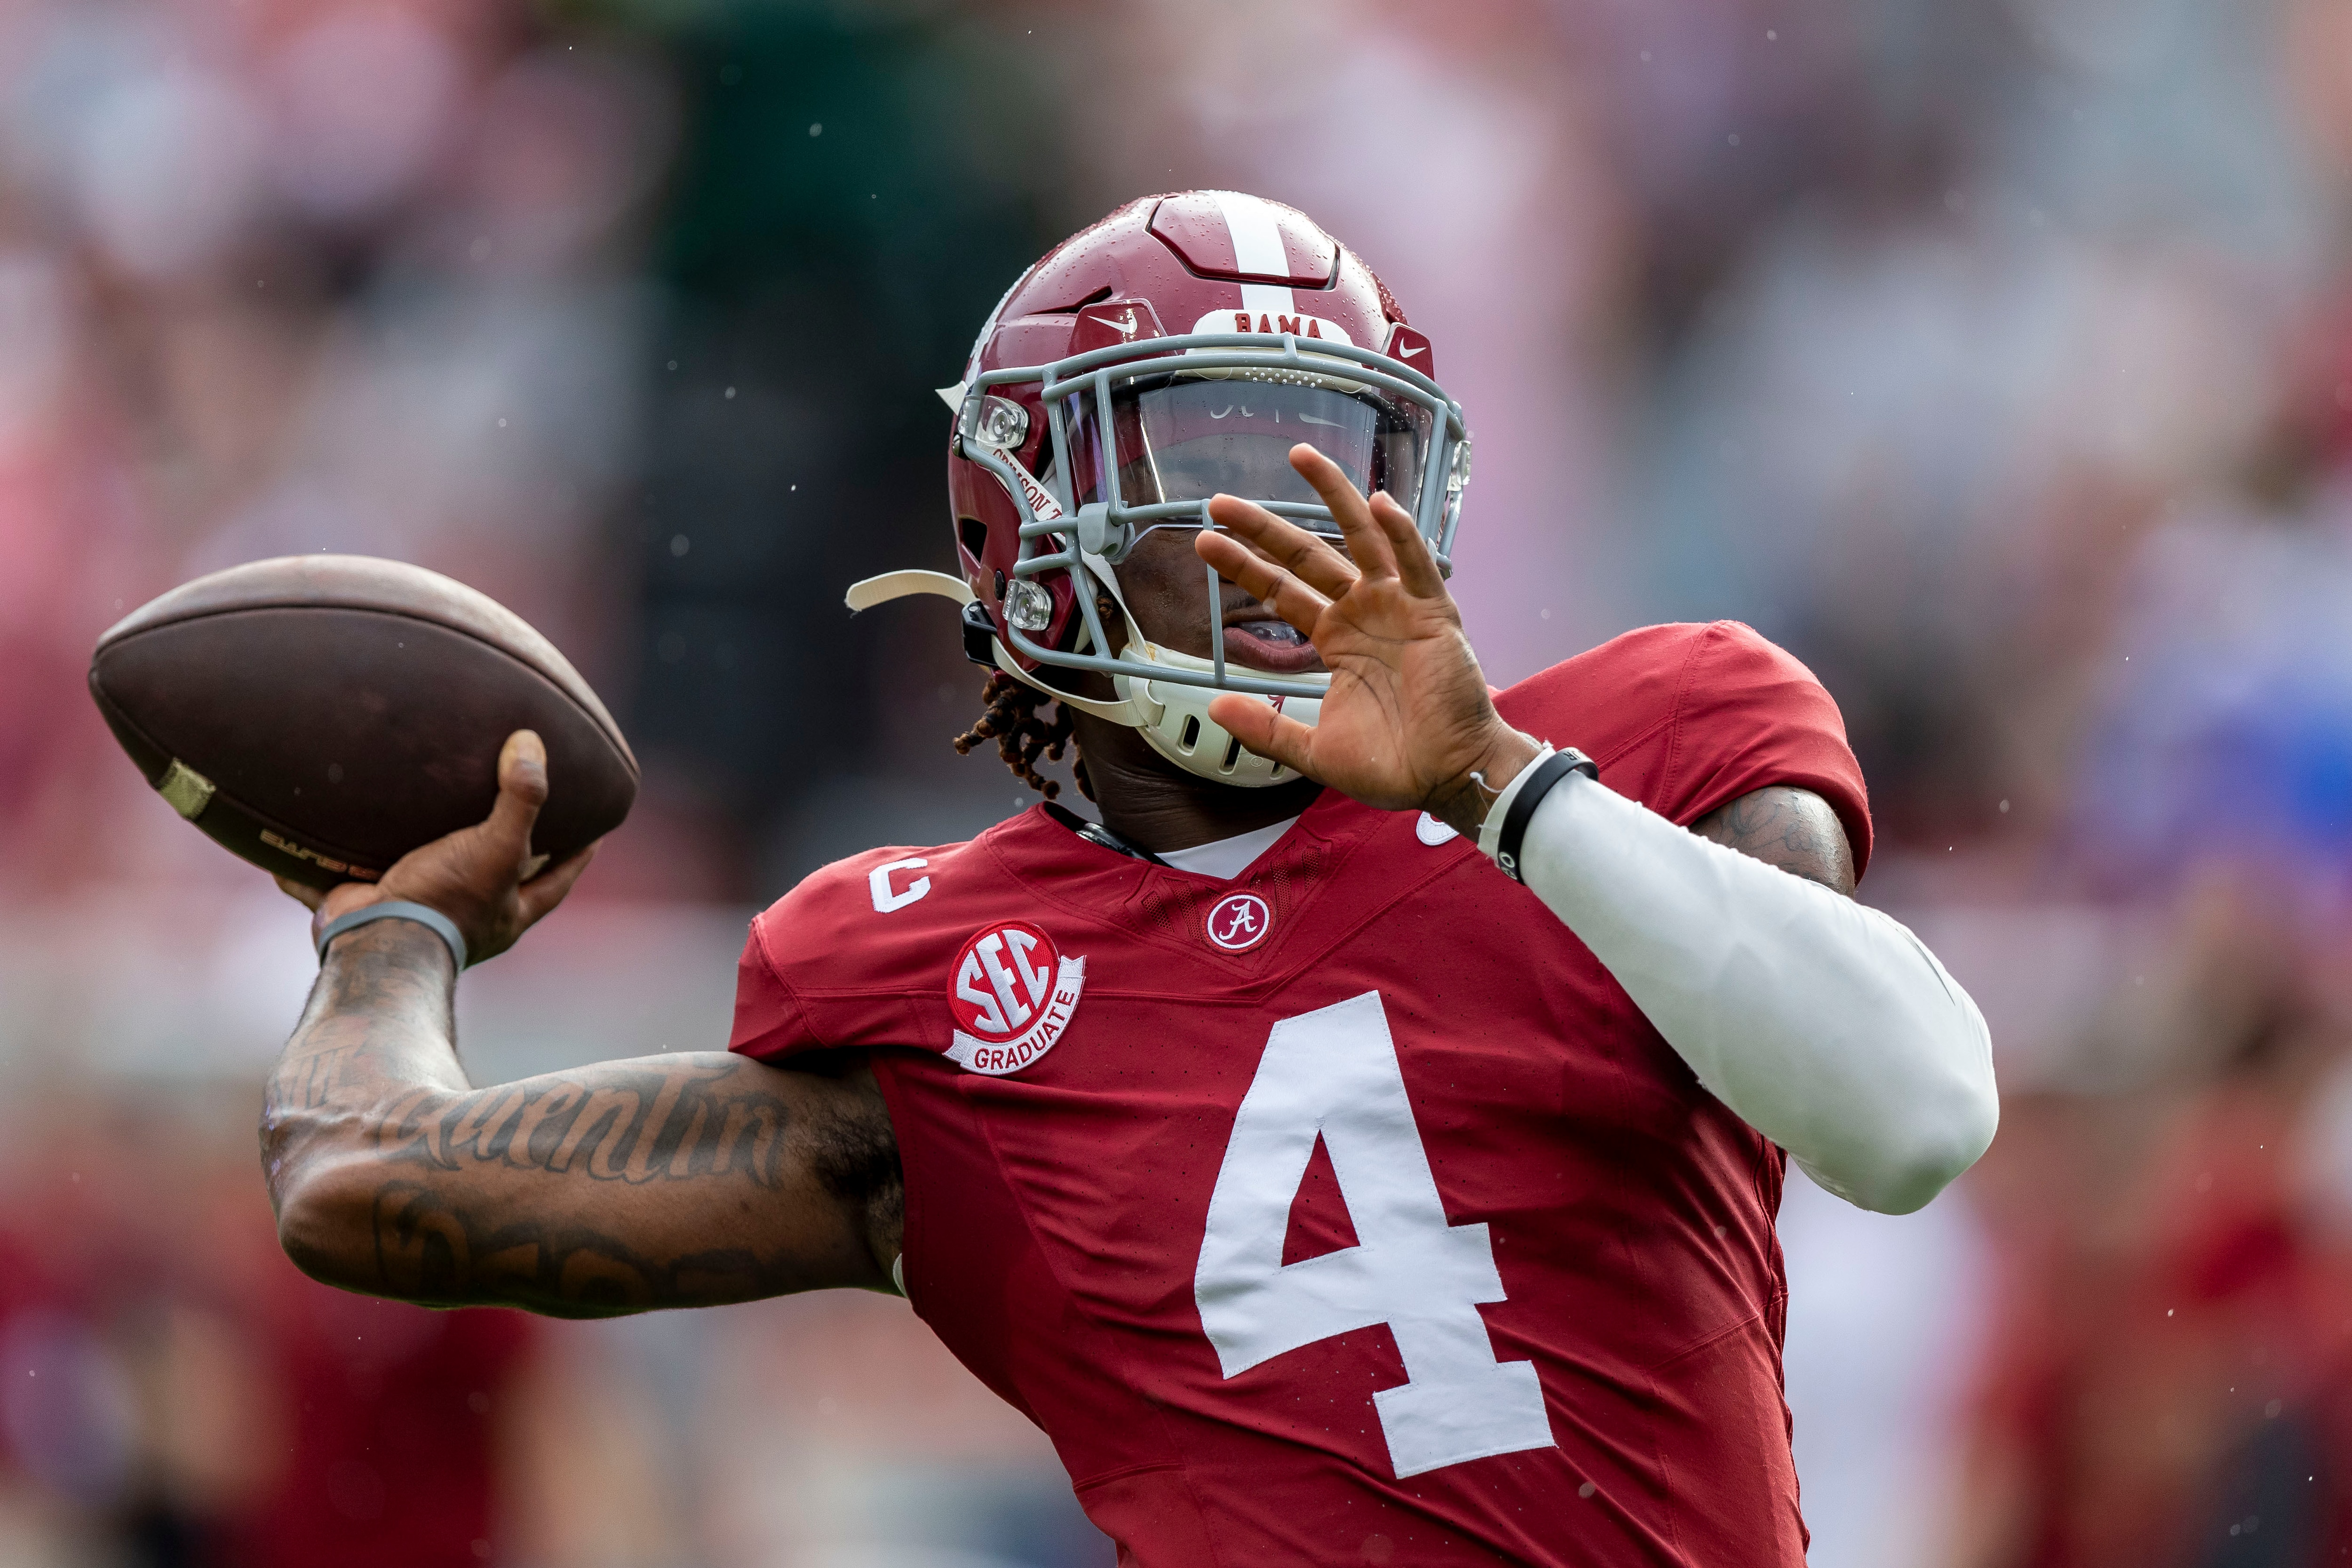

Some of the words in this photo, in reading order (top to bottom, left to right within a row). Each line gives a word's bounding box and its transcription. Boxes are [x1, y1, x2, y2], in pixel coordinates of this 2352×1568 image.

[1234, 313, 1323, 339] BAMA
[868, 857, 932, 914] C
[1218, 900, 1257, 940] A
[956, 929, 1049, 1033] SEC
[975, 990, 1075, 1070] GRADUATE
[1194, 990, 1558, 1479] 4
